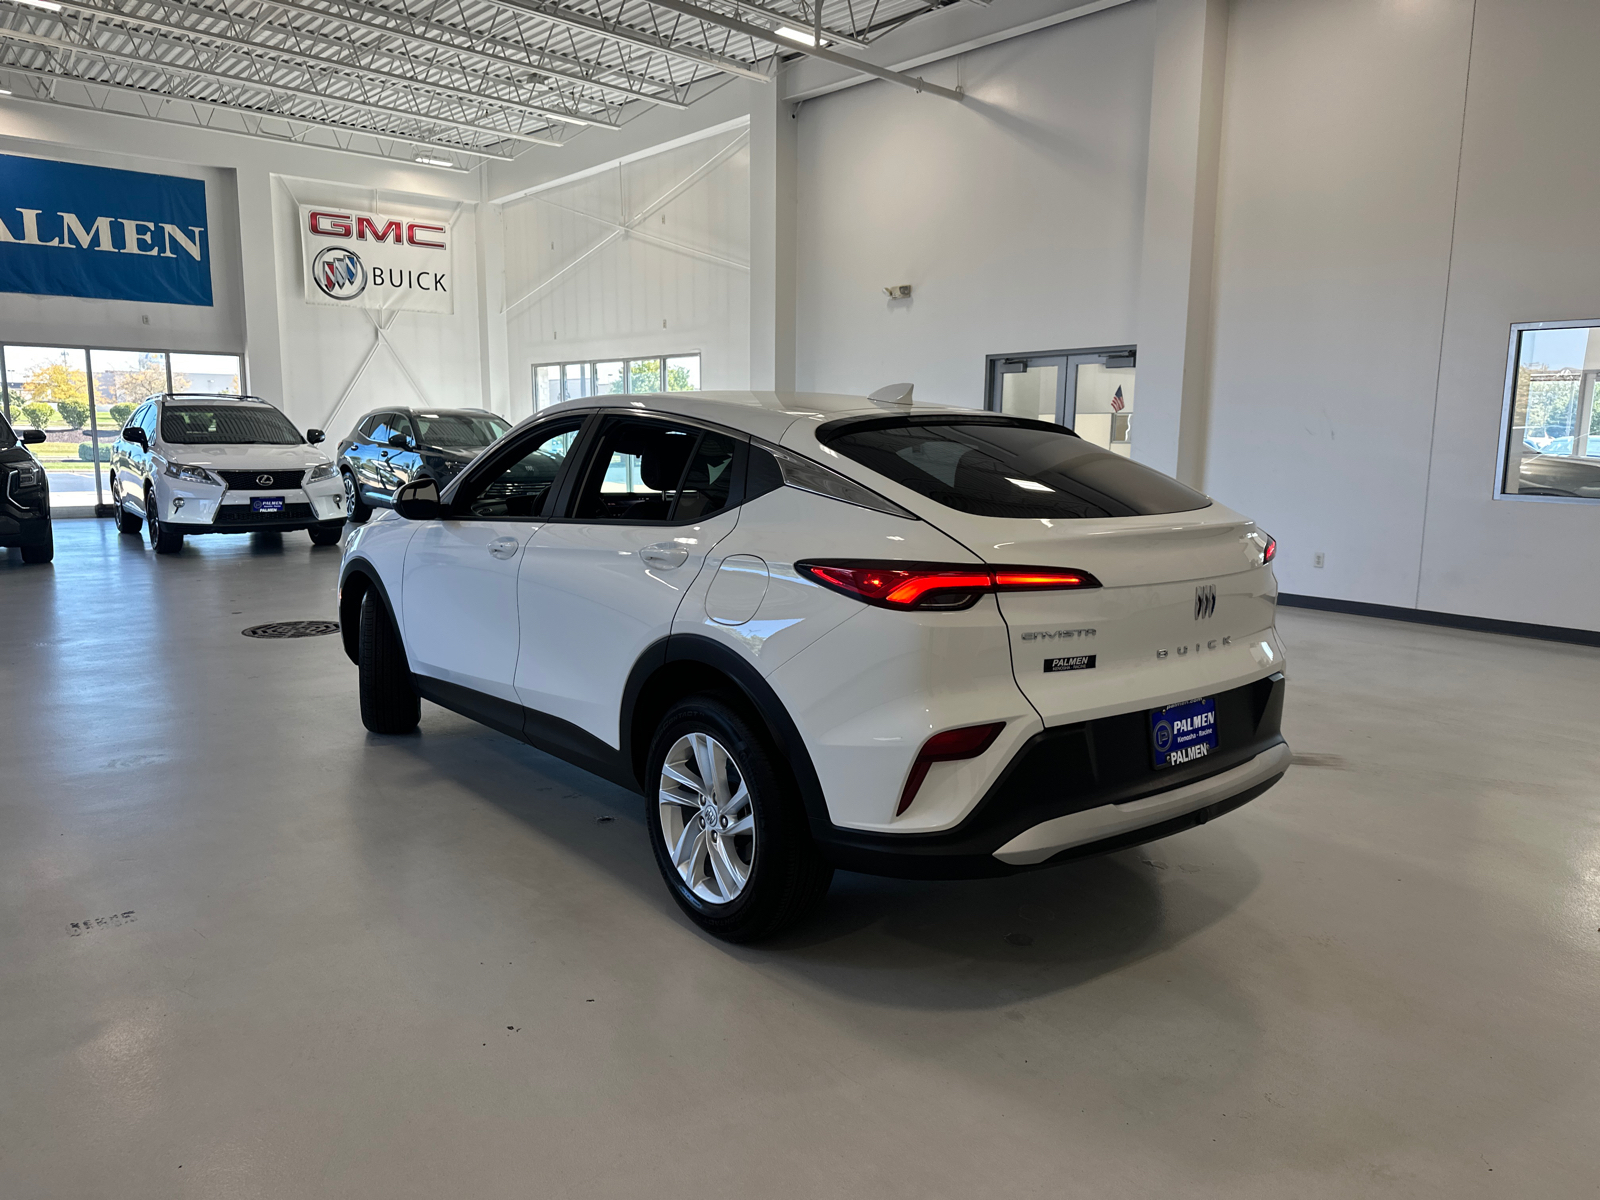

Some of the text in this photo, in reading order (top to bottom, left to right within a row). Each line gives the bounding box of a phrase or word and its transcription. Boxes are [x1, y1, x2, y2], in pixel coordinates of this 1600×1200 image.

[308, 209, 446, 250] GMC
[372, 267, 447, 292] BUICK
[1021, 628, 1096, 640] ENVISTA
[1157, 635, 1232, 659] BUICK
[1052, 656, 1089, 667] PALMEN
[1173, 711, 1215, 735] PALMEN
[1177, 728, 1213, 743] Kenosha Racine
[1170, 742, 1207, 766] PALMEN
